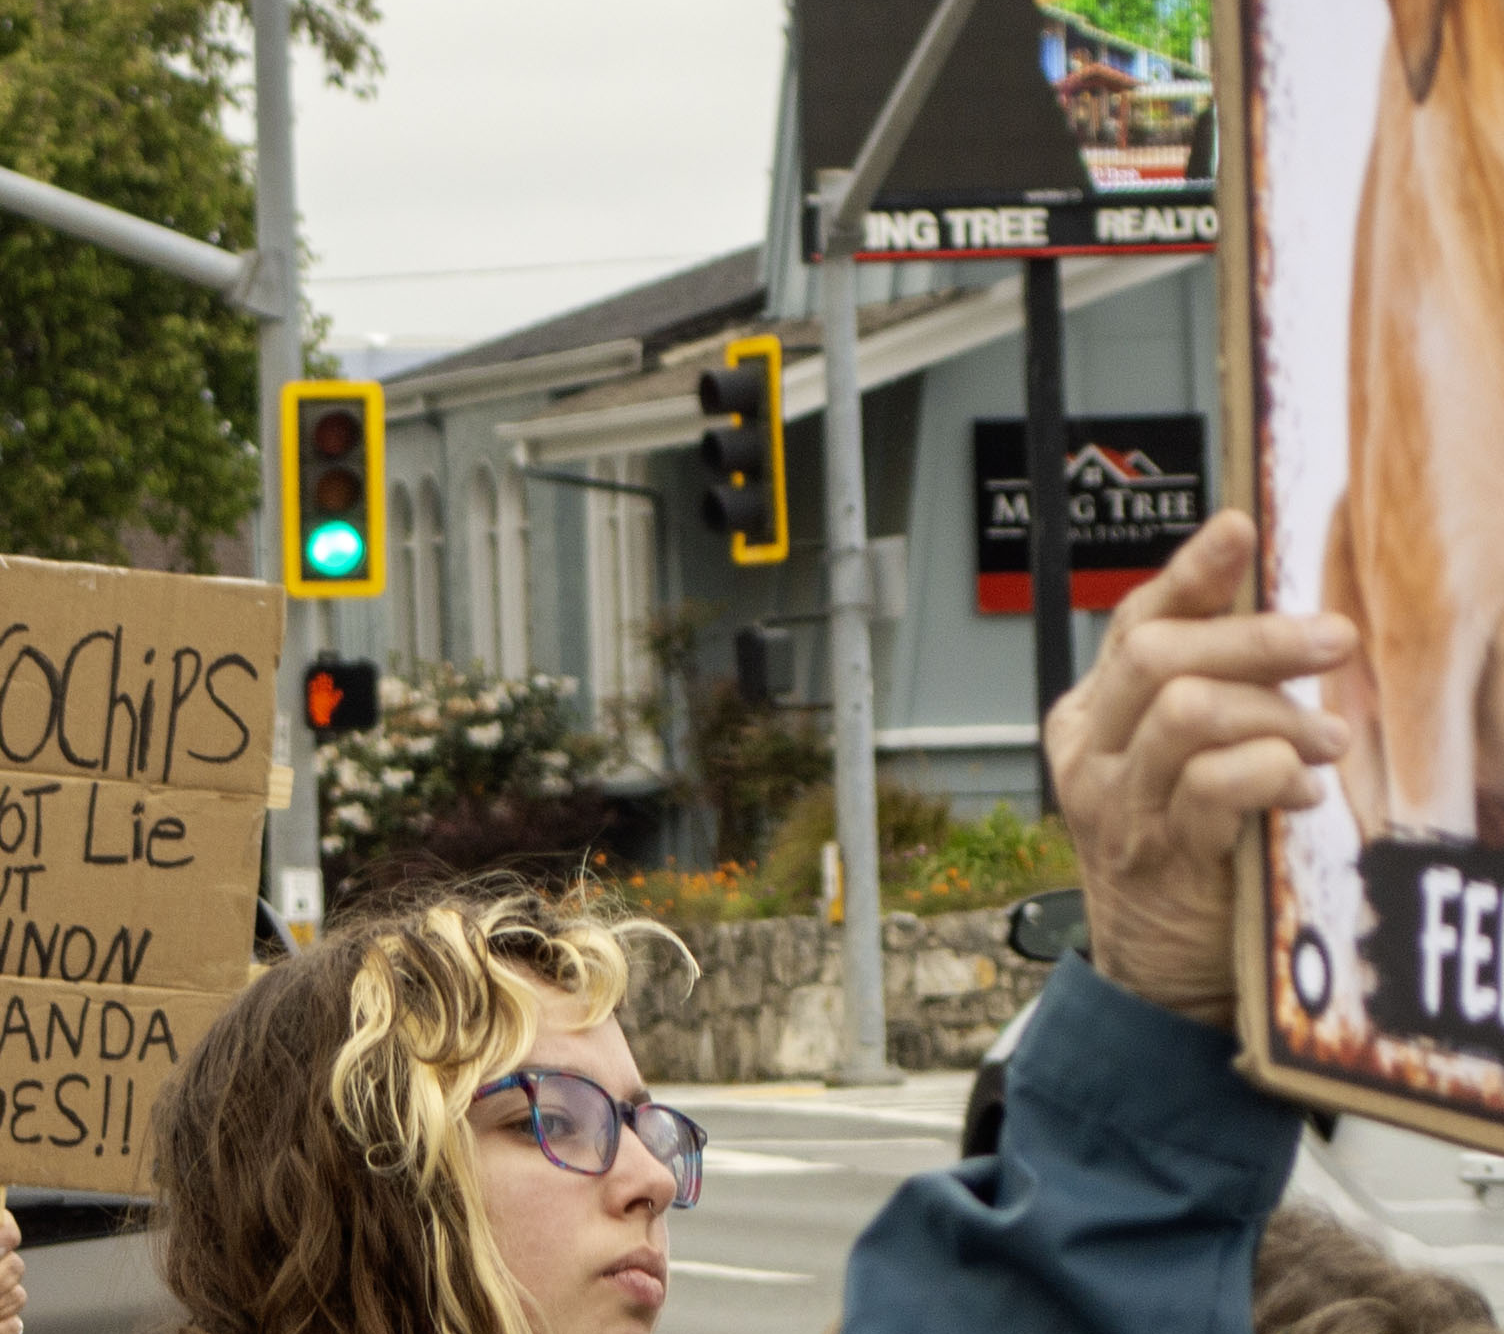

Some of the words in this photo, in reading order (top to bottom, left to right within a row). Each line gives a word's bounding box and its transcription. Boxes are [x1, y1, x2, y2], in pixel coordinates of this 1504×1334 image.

[864, 208, 941, 250] ING
[943, 207, 1051, 247] TREE
[1096, 204, 1219, 243] REALTO
[992, 493, 1096, 524] MG
[1104, 488, 1195, 521] TREE
